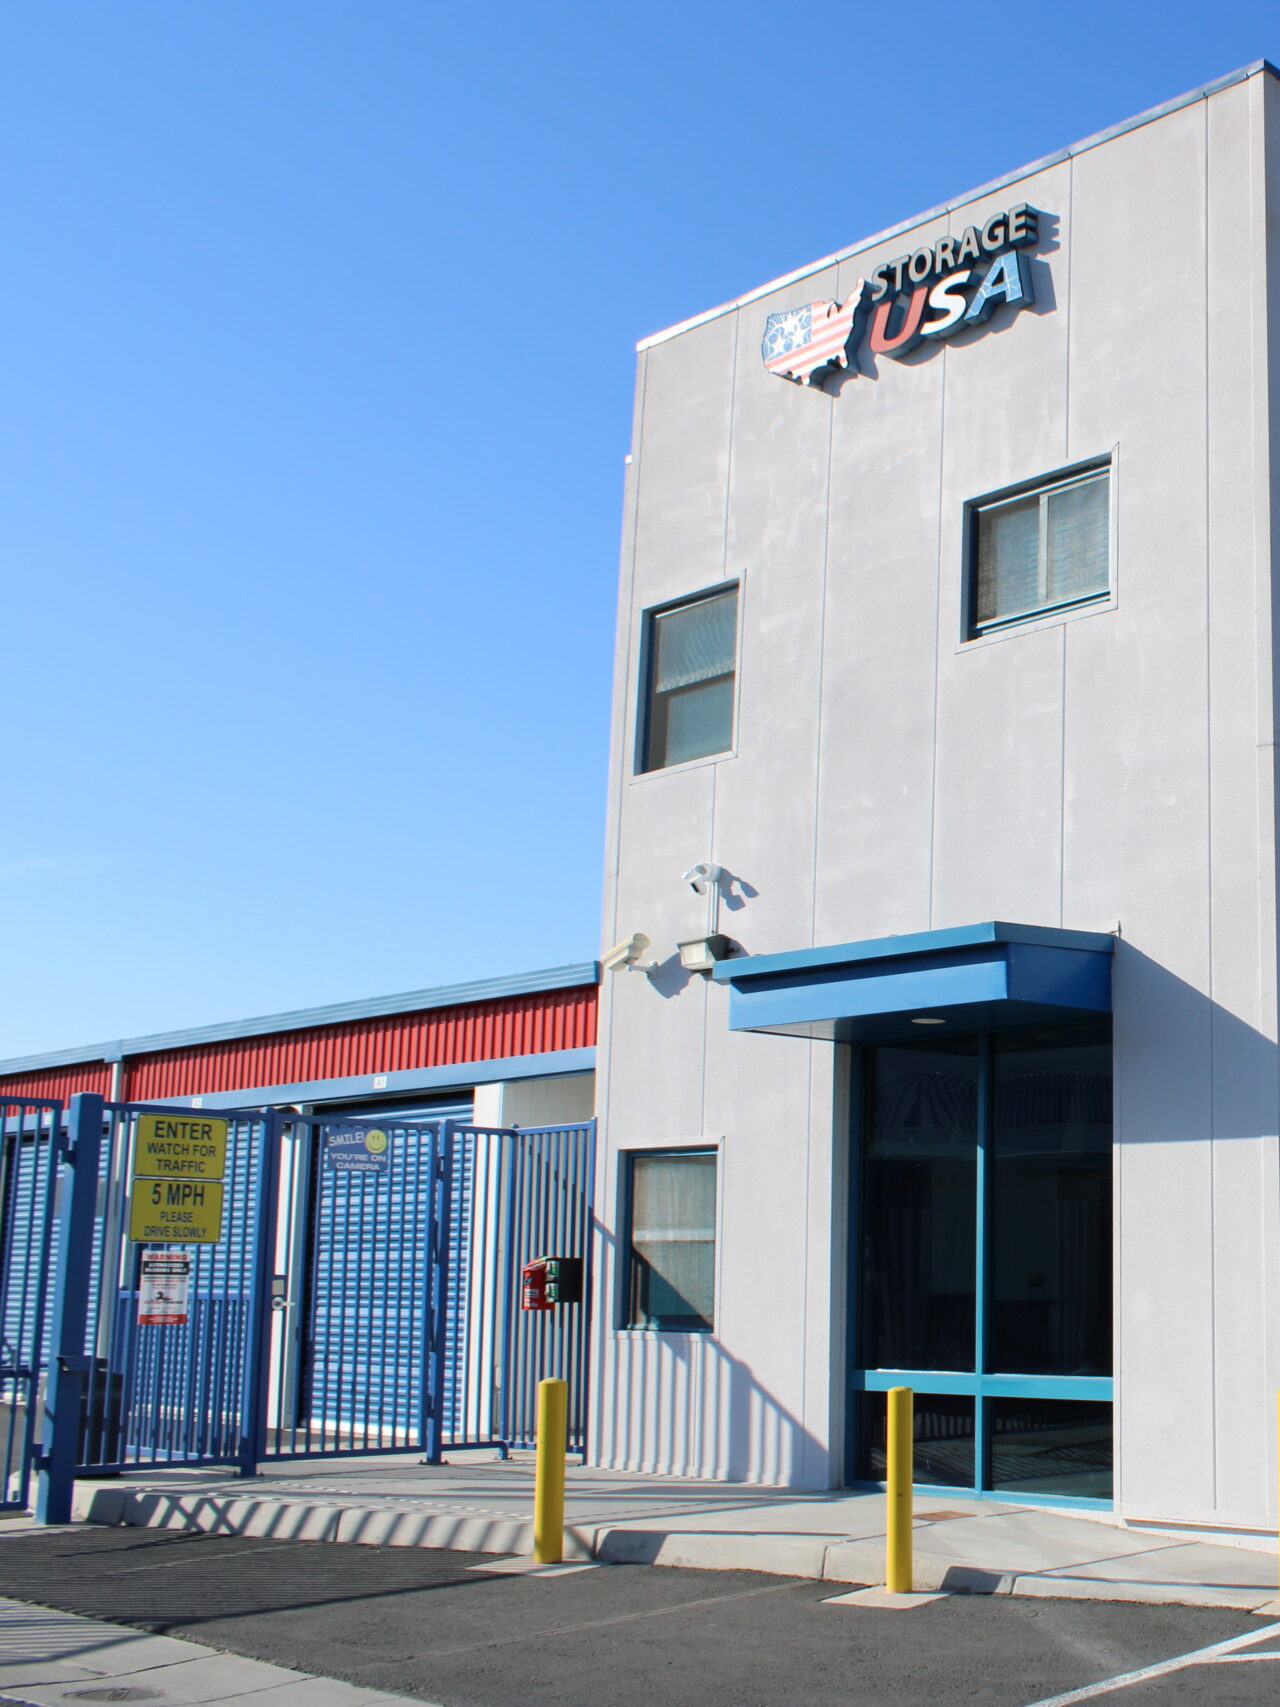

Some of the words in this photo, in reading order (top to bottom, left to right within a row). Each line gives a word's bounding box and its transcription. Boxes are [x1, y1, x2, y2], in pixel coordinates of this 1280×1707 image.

[871, 202, 1037, 301] STORAGE
[870, 249, 1031, 356] USA
[154, 1120, 212, 1140] ENTER
[147, 1142, 189, 1156] WATCH
[192, 1144, 216, 1157] FOR
[330, 1152, 369, 1161] YOU'RE
[370, 1154, 386, 1162] ON
[156, 1159, 206, 1173] TRAFFIC
[336, 1162, 380, 1170] CAMERA
[151, 1183, 161, 1205] 5
[166, 1184, 205, 1206] MPH
[160, 1211, 194, 1222] PLEASE
[144, 1225, 170, 1237] DRIVE
[172, 1226, 207, 1238] SLOWLY
